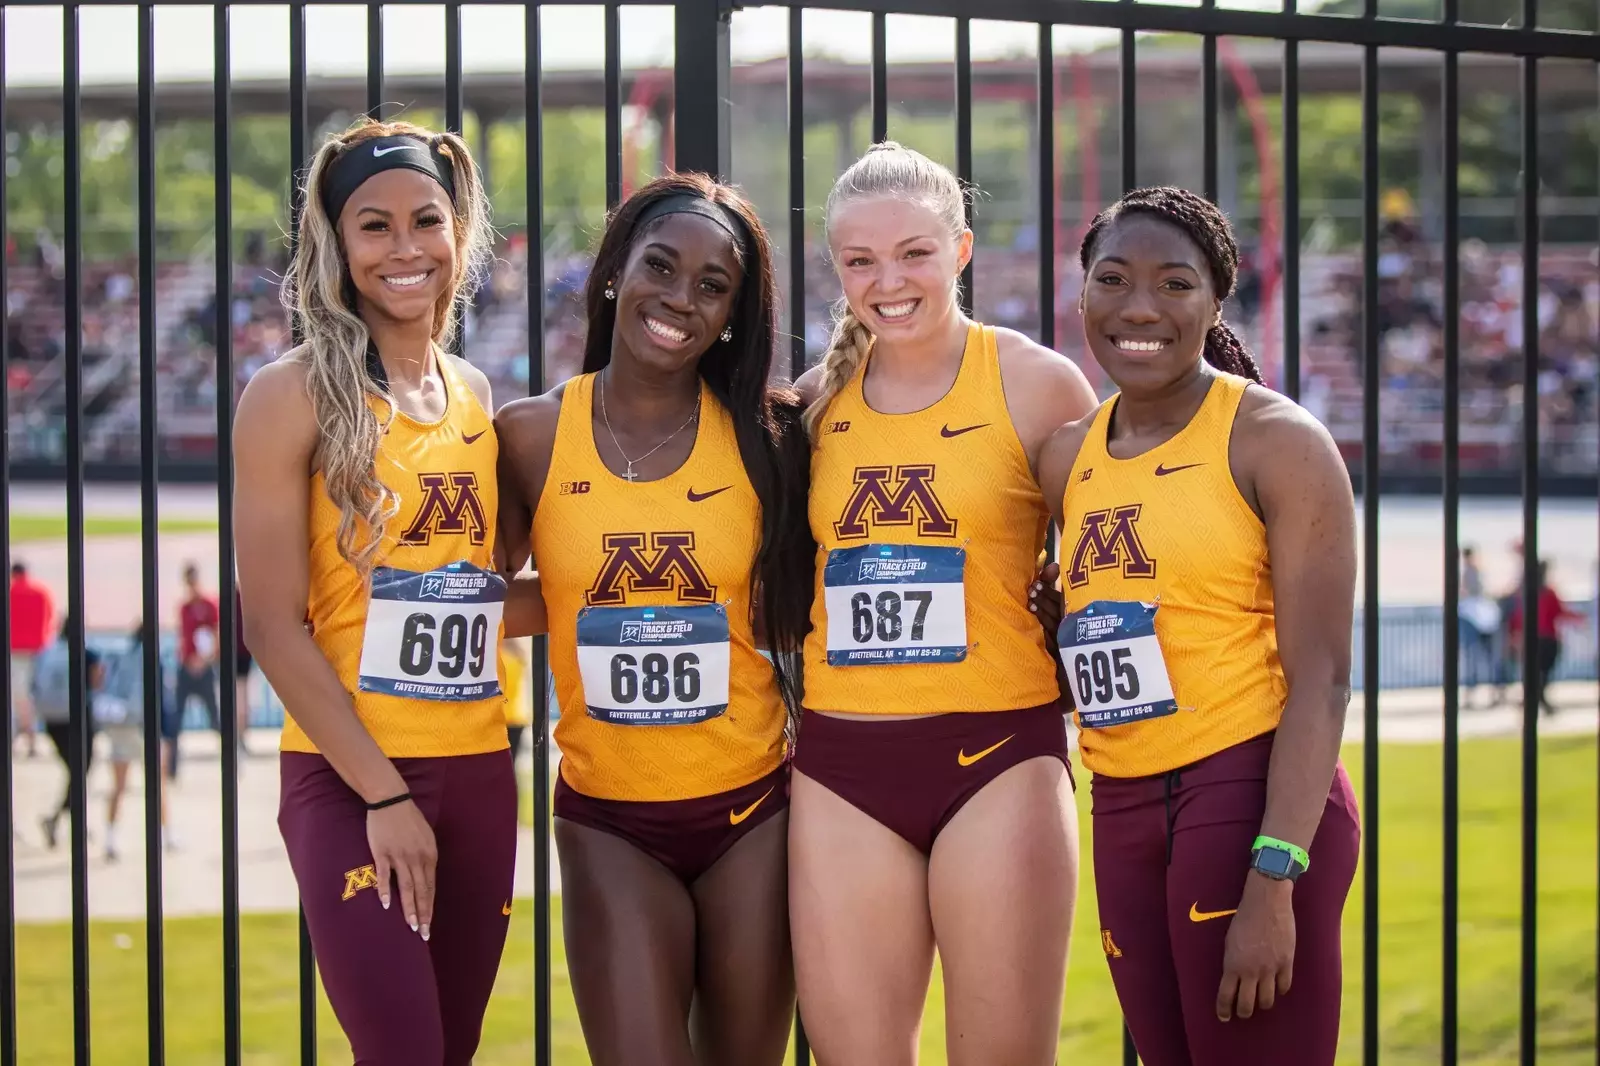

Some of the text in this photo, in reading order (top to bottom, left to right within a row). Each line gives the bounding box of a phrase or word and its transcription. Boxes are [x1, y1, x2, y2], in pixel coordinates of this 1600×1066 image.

[397, 472, 487, 546] M
[833, 464, 958, 540] M
[1066, 504, 1156, 590] M
[445, 578, 469, 588] TRACK
[473, 578, 488, 588] FIELD
[585, 531, 717, 606] M
[878, 562, 902, 571] TRACK
[907, 561, 927, 570] FIELD
[642, 625, 666, 633] TRACK
[673, 623, 693, 633] FIELD
[850, 590, 933, 644] 687
[1106, 618, 1124, 628] FIELD
[399, 612, 488, 679] 699
[885, 650, 894, 658] AR
[905, 649, 921, 657] MAY
[445, 686, 456, 695] AR
[610, 652, 700, 704] 686
[1074, 647, 1140, 706] 695
[609, 711, 651, 720] FAYETTEVILLE,
[651, 711, 661, 719] AR
[672, 710, 688, 718] MAY
[1120, 708, 1134, 717] MAY
[342, 864, 378, 901] M
